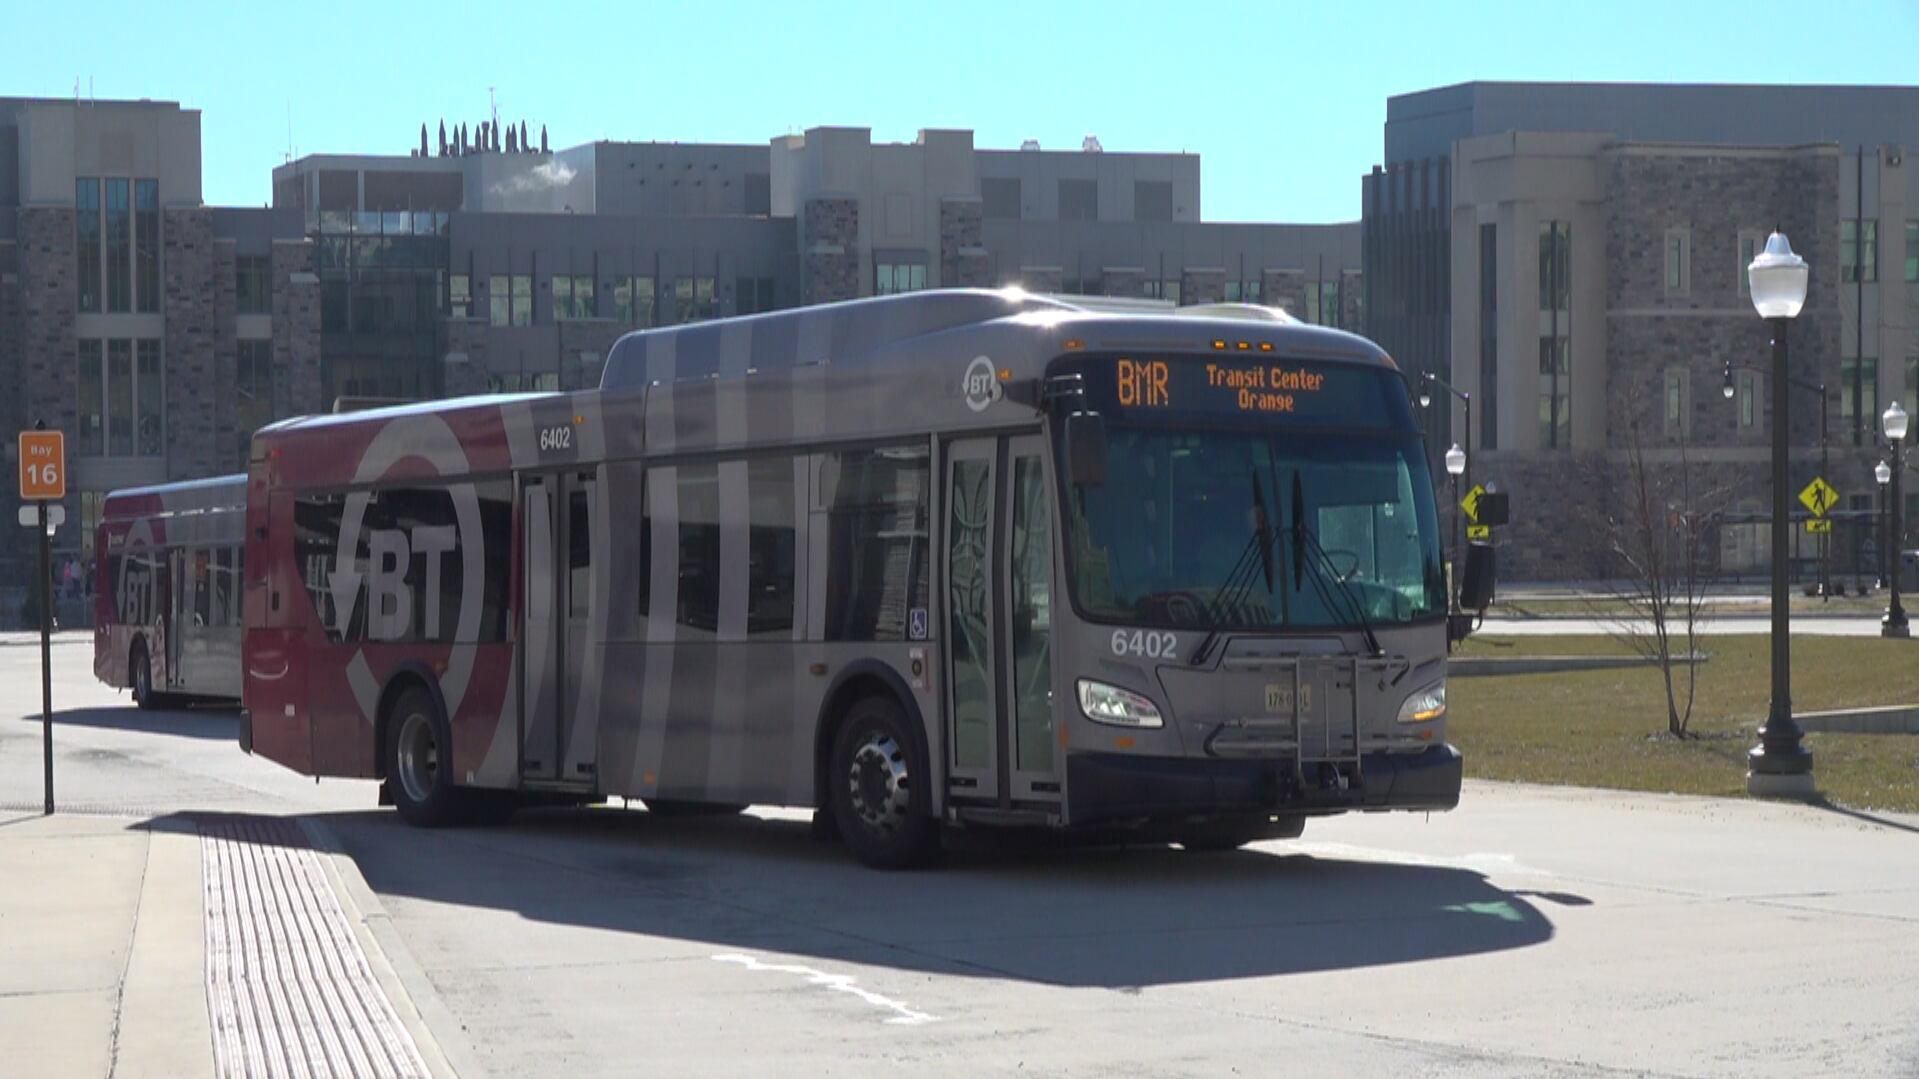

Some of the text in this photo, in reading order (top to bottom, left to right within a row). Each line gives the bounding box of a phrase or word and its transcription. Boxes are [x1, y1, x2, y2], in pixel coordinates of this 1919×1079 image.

[970, 374, 990, 395] BT
[1118, 359, 1168, 406] BMR
[1206, 364, 1324, 391] Transit Center
[1238, 388, 1294, 412] Orange
[31, 444, 53, 457] Bay
[540, 426, 570, 451] 6402
[27, 463, 58, 485] 16
[368, 525, 456, 640] BT
[126, 571, 150, 625] BT
[1111, 629, 1177, 658] 6402
